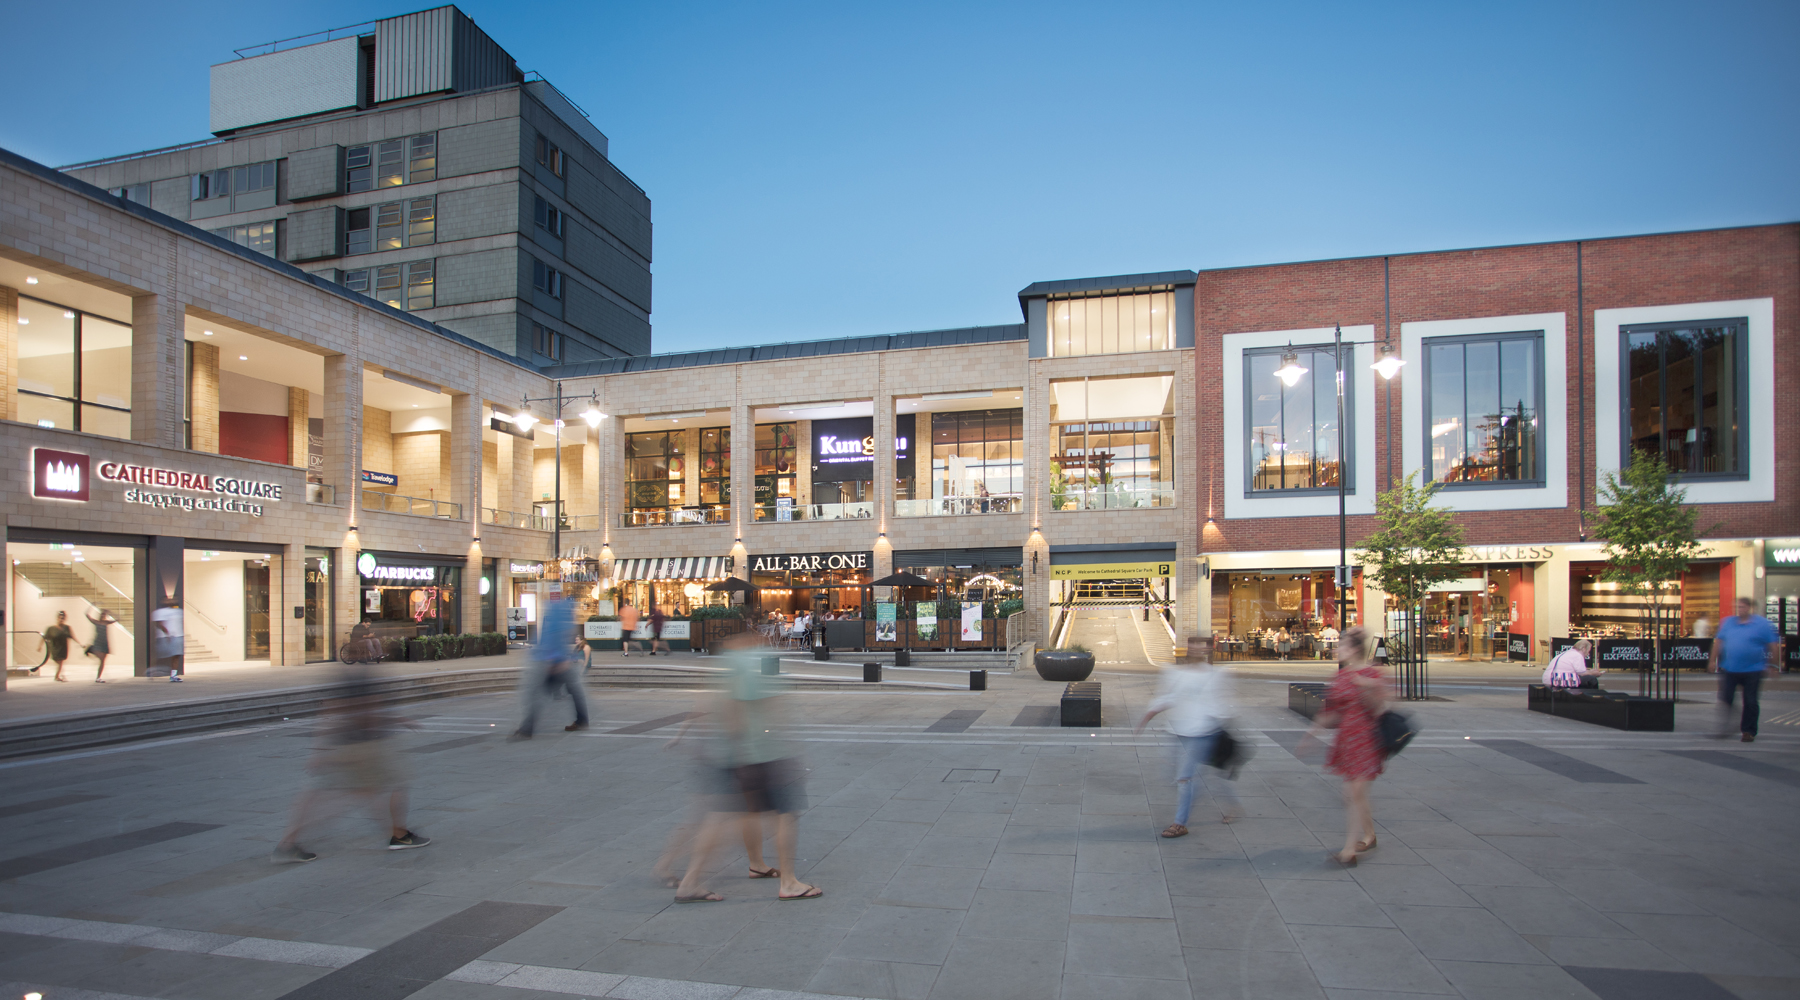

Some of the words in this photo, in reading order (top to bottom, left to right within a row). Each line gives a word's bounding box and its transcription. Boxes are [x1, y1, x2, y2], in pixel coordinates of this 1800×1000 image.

[99, 462, 213, 492] CATHEDRAL
[214, 477, 282, 500] SQUARE
[126, 488, 195, 511] shopping
[197, 497, 223, 512] and
[224, 500, 263, 517] dining
[753, 556, 783, 571] ALL
[789, 555, 822, 570] BAR
[828, 554, 866, 569] ONE
[1160, 566, 1168, 574] P
[559, 570, 598, 582] TALIAN
